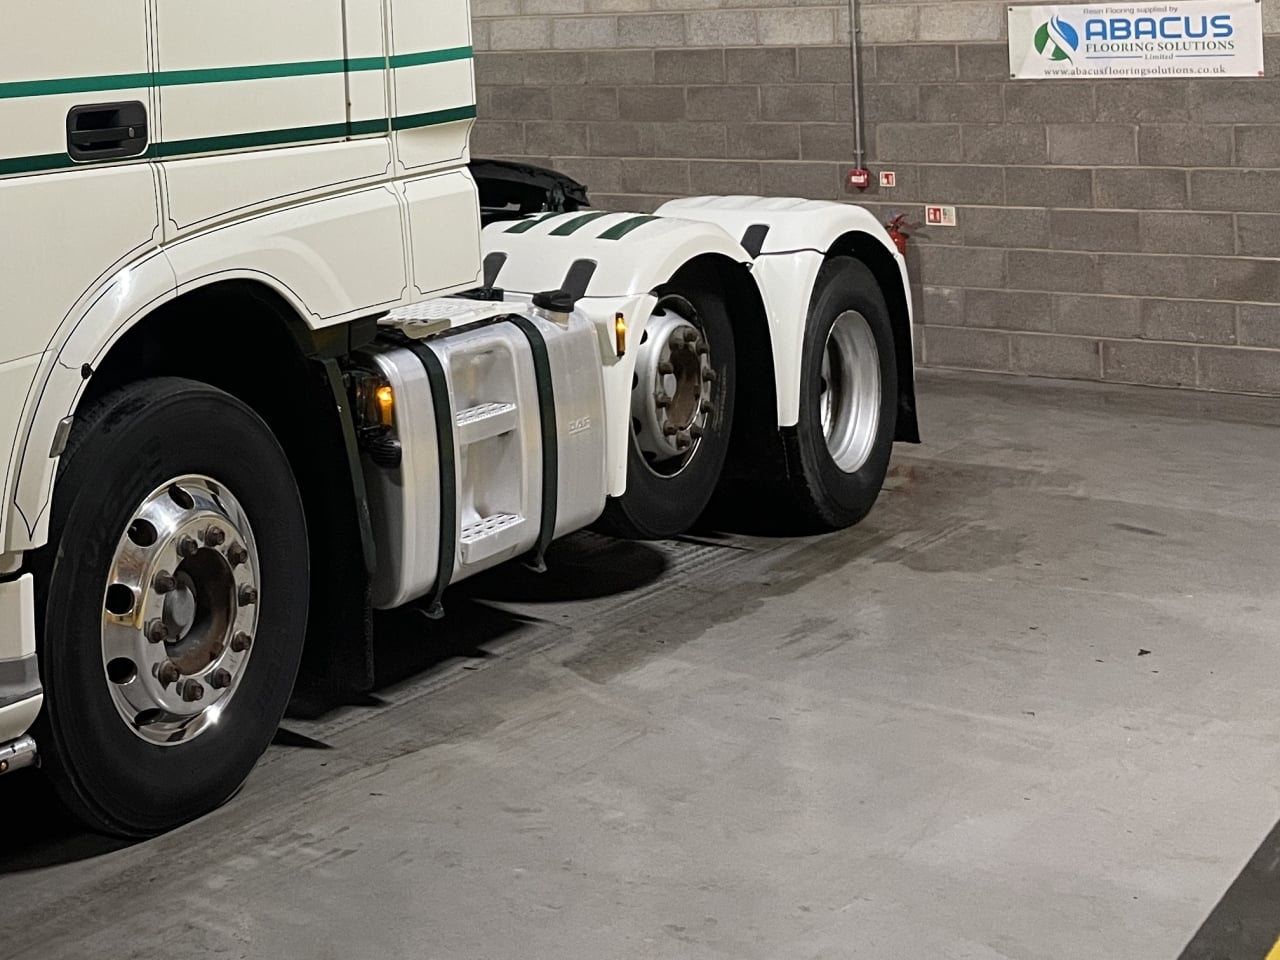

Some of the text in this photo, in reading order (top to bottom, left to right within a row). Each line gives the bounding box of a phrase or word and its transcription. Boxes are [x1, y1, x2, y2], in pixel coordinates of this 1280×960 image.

[1106, 6, 1135, 15] Flooring
[1136, 5, 1167, 14] supplied
[1169, 5, 1178, 13] by
[1085, 15, 1234, 41] ABACUS
[1085, 40, 1235, 53] FLOORING SOLUTIONS
[1144, 53, 1174, 61] Limited
[1044, 64, 1227, 77] www.abacusflooringsolutions.co.uk
